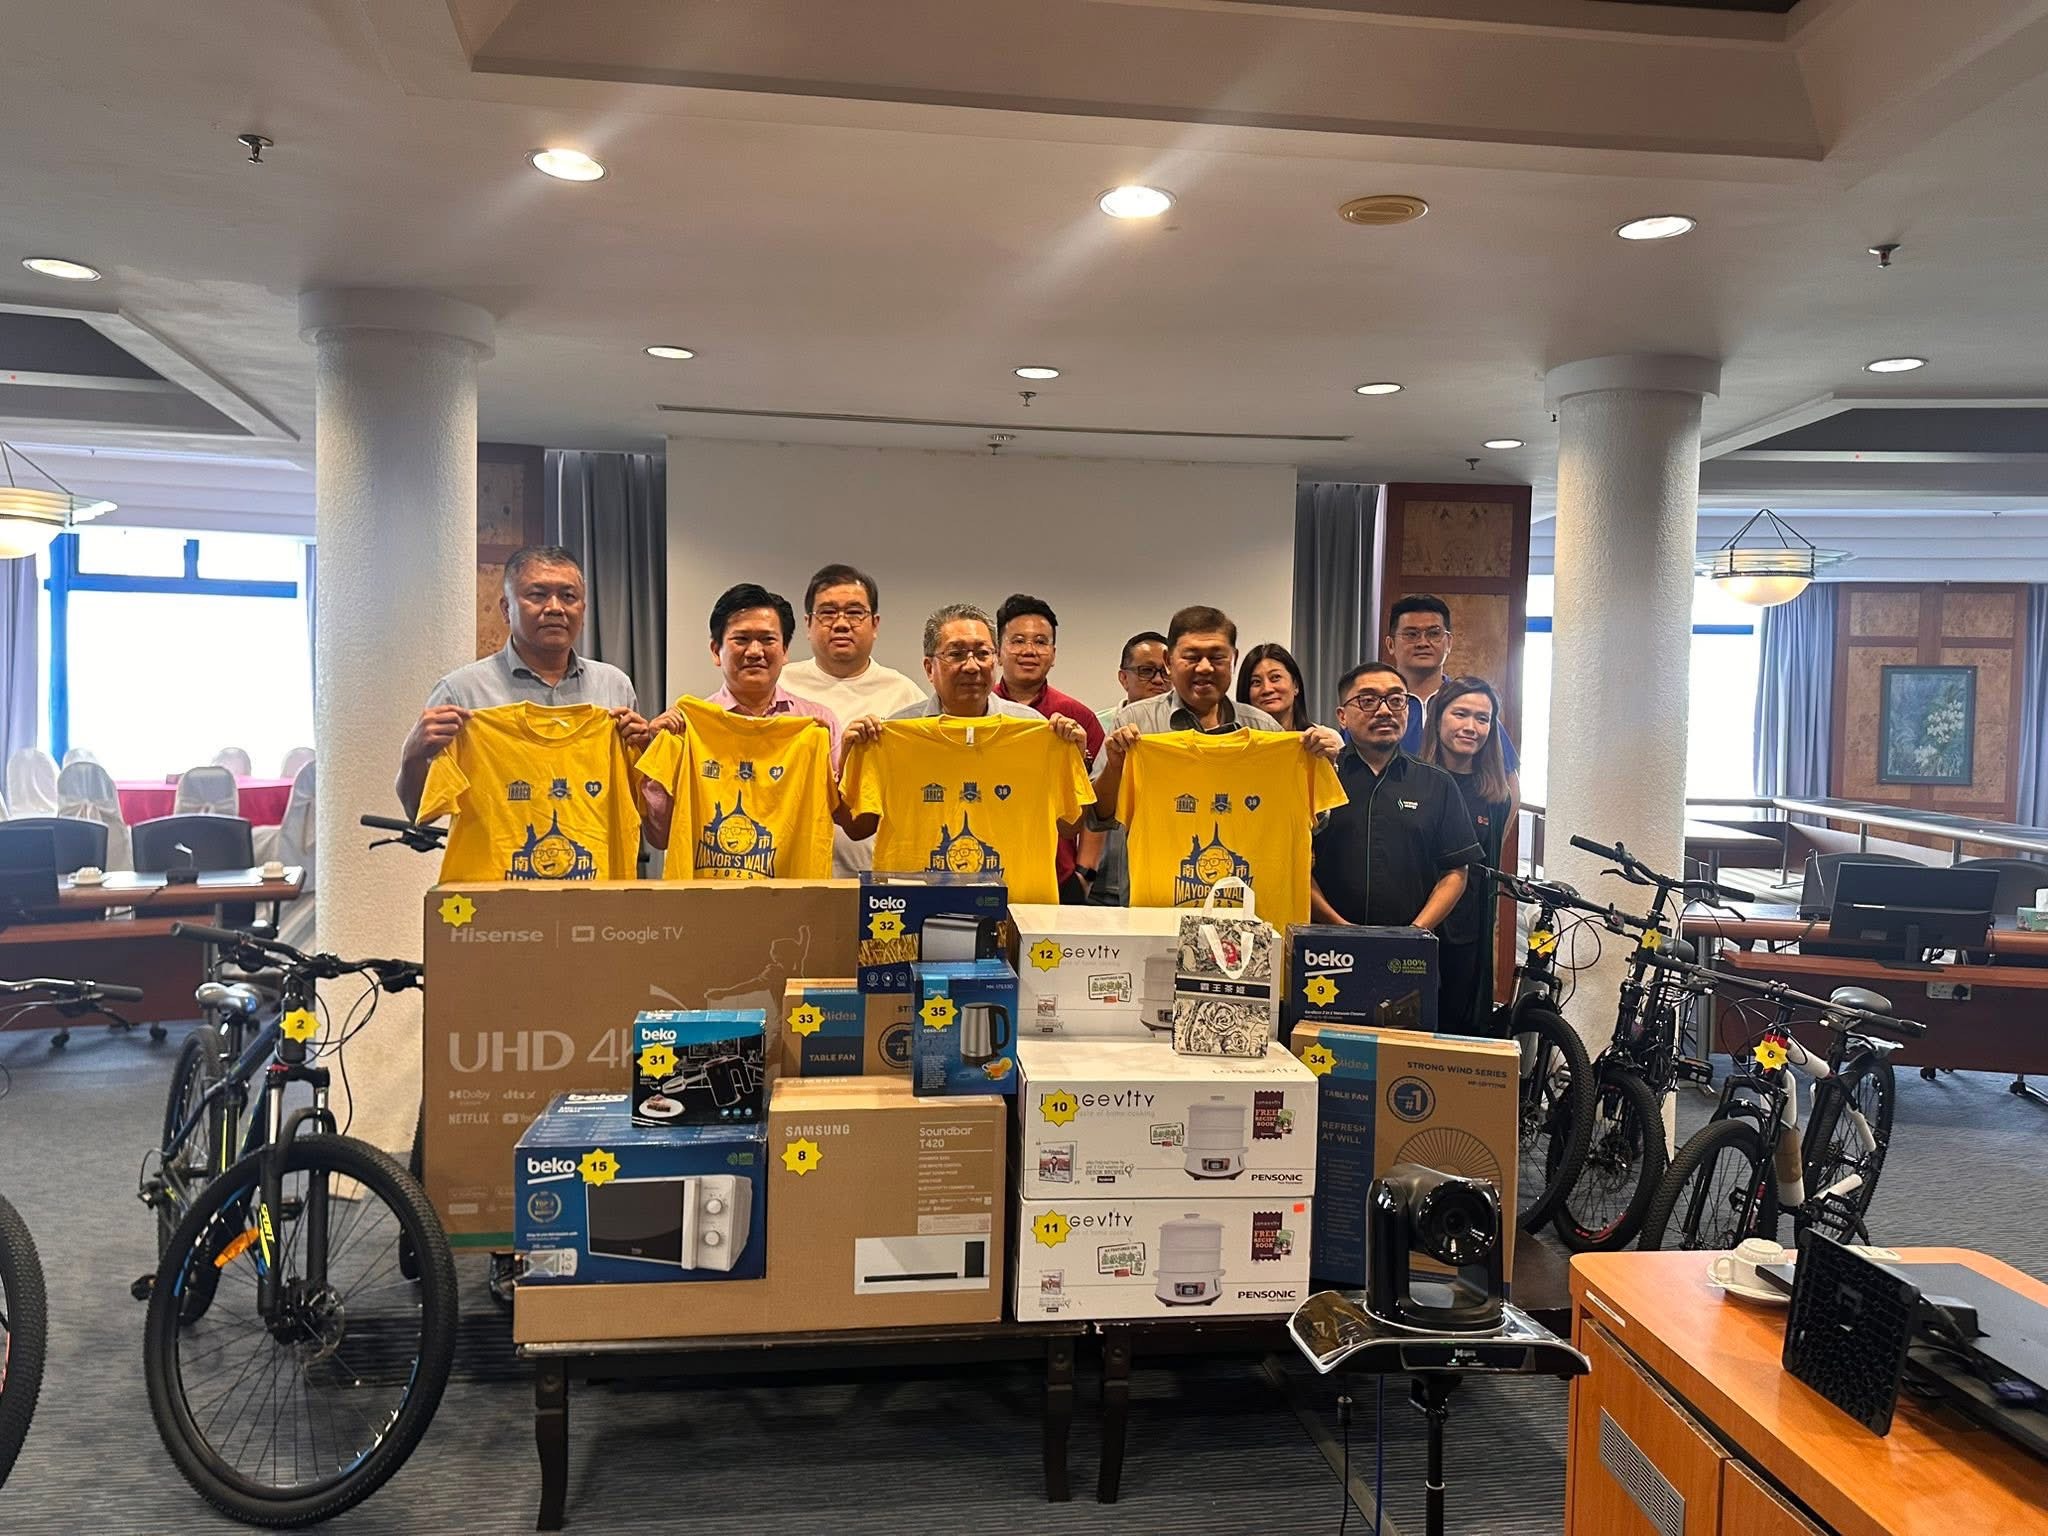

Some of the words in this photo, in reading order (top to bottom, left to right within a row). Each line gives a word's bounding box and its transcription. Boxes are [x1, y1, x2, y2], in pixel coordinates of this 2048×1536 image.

[588, 784, 599, 792] 38
[998, 787, 1008, 795] 38
[1248, 798, 1257, 806] 38
[697, 847, 742, 868] MAYOR'S
[744, 850, 775, 877] WALK
[713, 869, 754, 879] 2025
[1176, 878, 1221, 904] MAYORS
[868, 895, 907, 910] beko
[1194, 900, 1233, 909] 225
[454, 905, 461, 914] 1
[879, 921, 895, 931] 32
[450, 927, 544, 943] Hisense
[601, 926, 659, 944] Google
[663, 927, 684, 940] TV
[1039, 950, 1053, 959] 12
[1304, 949, 1354, 967] beko
[1317, 986, 1325, 995] 9
[930, 1006, 947, 1016] 35
[798, 1014, 814, 1024] 33
[296, 1020, 305, 1029] 2
[641, 1028, 677, 1040] beko
[448, 1030, 576, 1073] UHD
[1767, 1050, 1775, 1059] 6
[649, 1055, 665, 1066] 31
[809, 1053, 836, 1062] TABLE
[838, 1053, 857, 1062] FAN
[1310, 1054, 1326, 1065] 34
[1407, 1061, 1445, 1072] STRONG
[1447, 1065, 1473, 1075] WIND
[1474, 1068, 1508, 1079] SERIES
[462, 1088, 491, 1100] Dolby
[1325, 1089, 1351, 1099] TABLE
[1351, 1092, 1369, 1101] FAN
[1051, 1102, 1068, 1112] 10
[1255, 1108, 1278, 1116] FREE
[448, 1112, 490, 1125] NETFLIX
[785, 1123, 851, 1137] SAMSUNG
[919, 1126, 973, 1137] Soundbar
[1321, 1121, 1366, 1133] REFRESH
[1321, 1132, 1334, 1141] AT
[1335, 1134, 1361, 1144] WILL
[919, 1138, 945, 1149] T420
[797, 1150, 806, 1160] 8
[527, 1157, 576, 1174] beko
[591, 1162, 608, 1172] 15
[1251, 1173, 1303, 1182] PENSONIC
[1044, 1223, 1058, 1233] 11
[1237, 1290, 1297, 1298] PENSONIC
